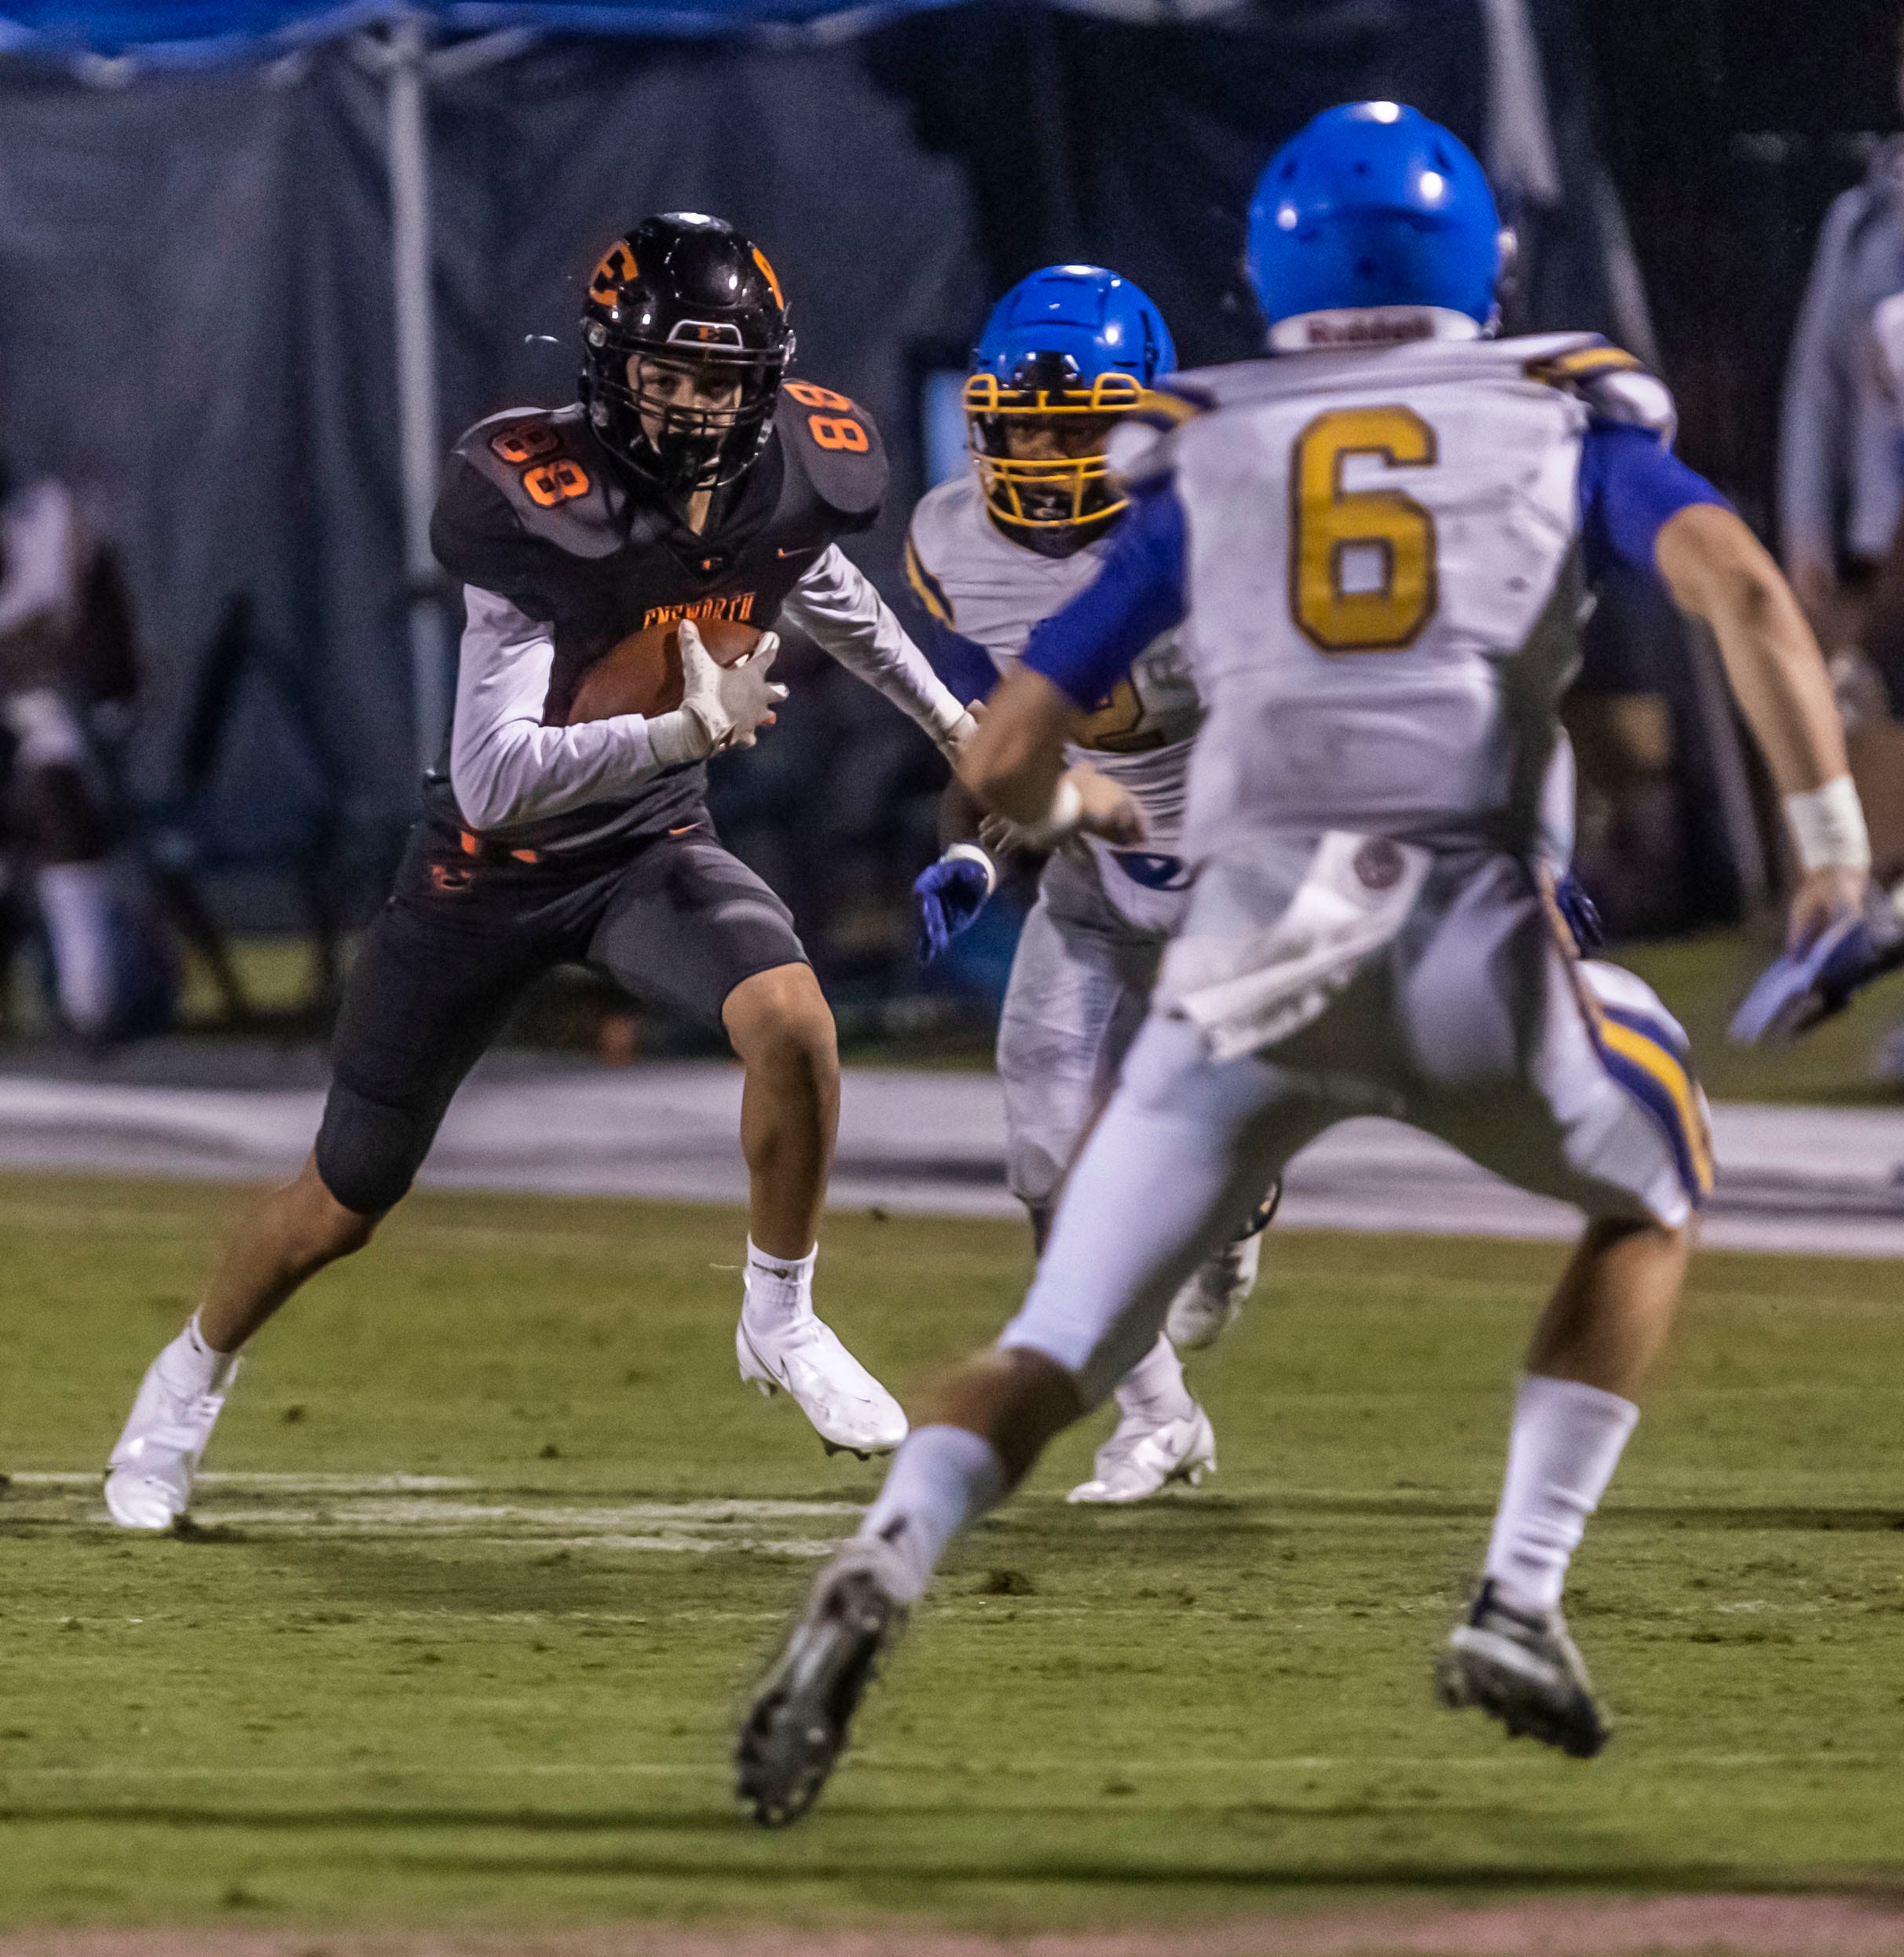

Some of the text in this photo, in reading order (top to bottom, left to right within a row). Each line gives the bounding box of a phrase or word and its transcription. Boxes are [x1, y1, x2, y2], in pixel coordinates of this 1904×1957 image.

[782, 380, 869, 452] 88
[490, 424, 590, 507] 88
[1290, 404, 1439, 654] 6
